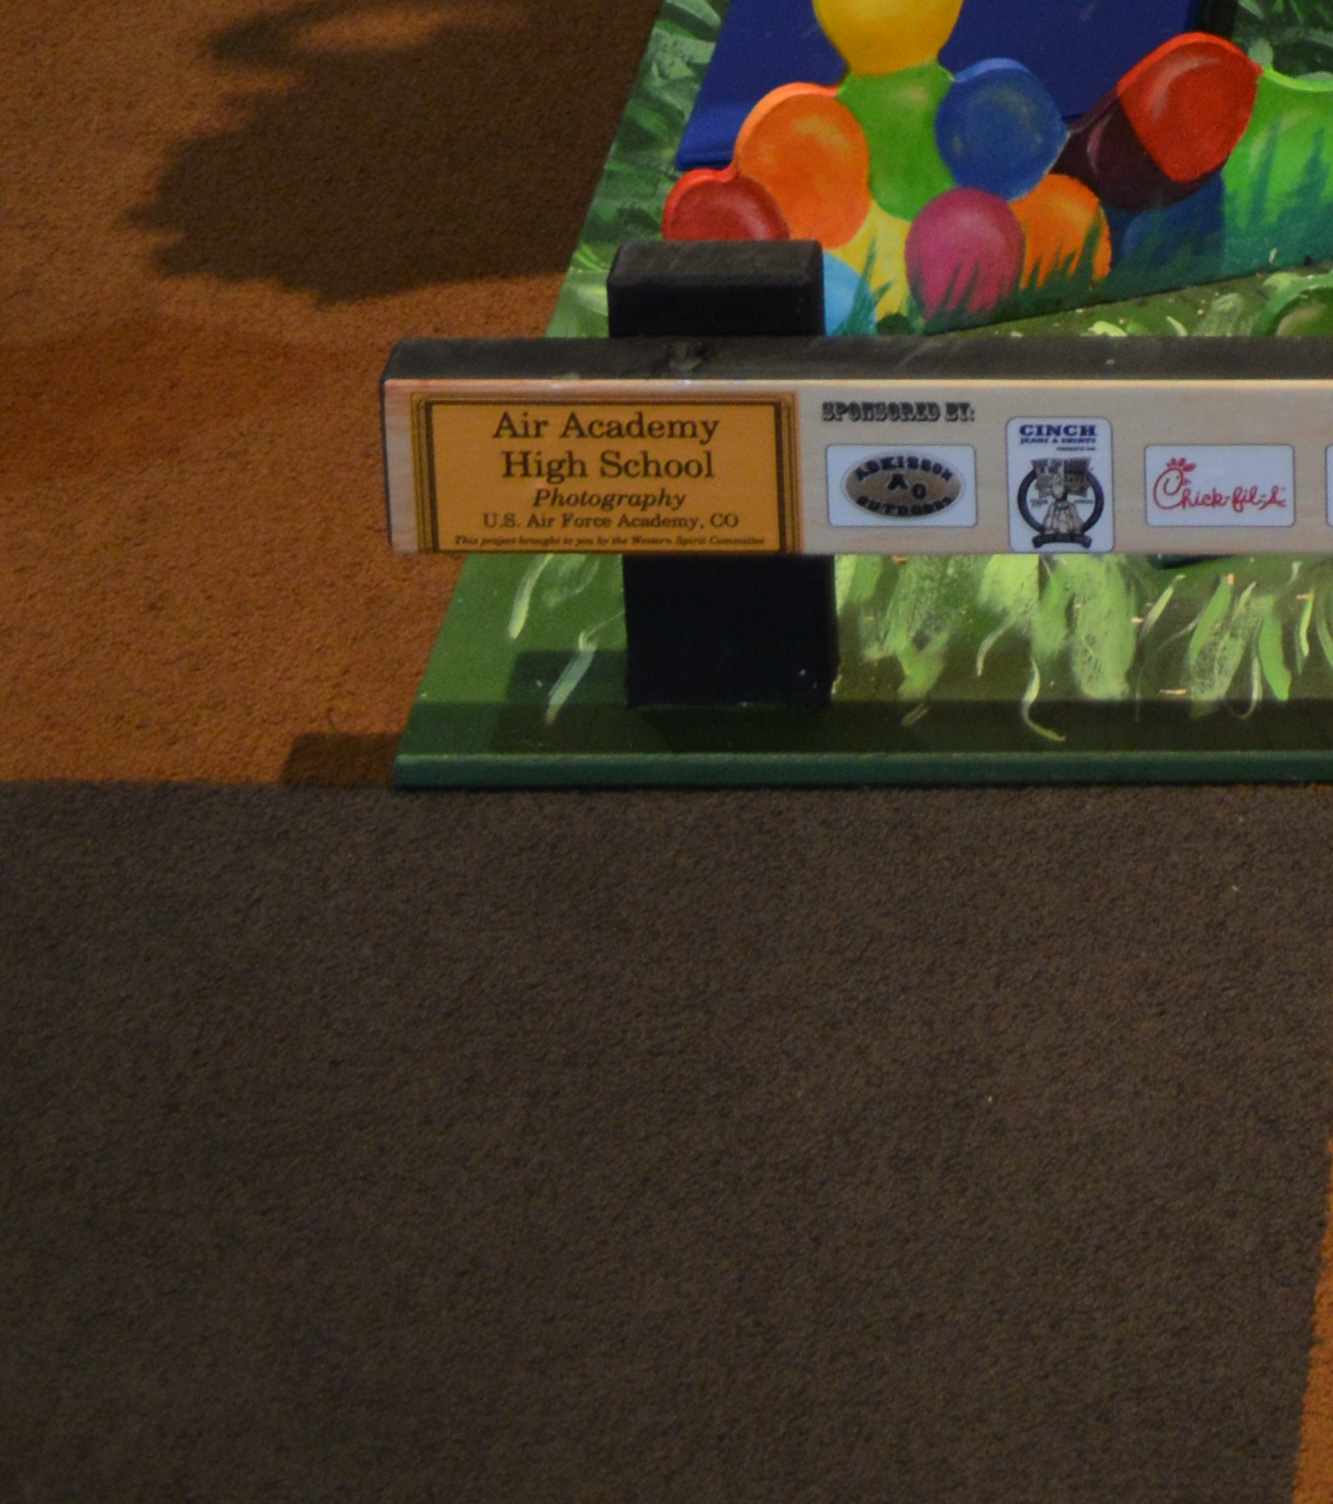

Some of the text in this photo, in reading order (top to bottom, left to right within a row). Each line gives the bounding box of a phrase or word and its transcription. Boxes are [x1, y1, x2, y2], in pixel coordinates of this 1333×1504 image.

[821, 400, 976, 423] SPONSORED BY:
[493, 410, 721, 445] Air Academy
[1018, 423, 1098, 437] CINCH
[502, 449, 716, 484] High School
[532, 487, 686, 511] Photography
[483, 512, 740, 531] U.S. Air Force Academy, CO
